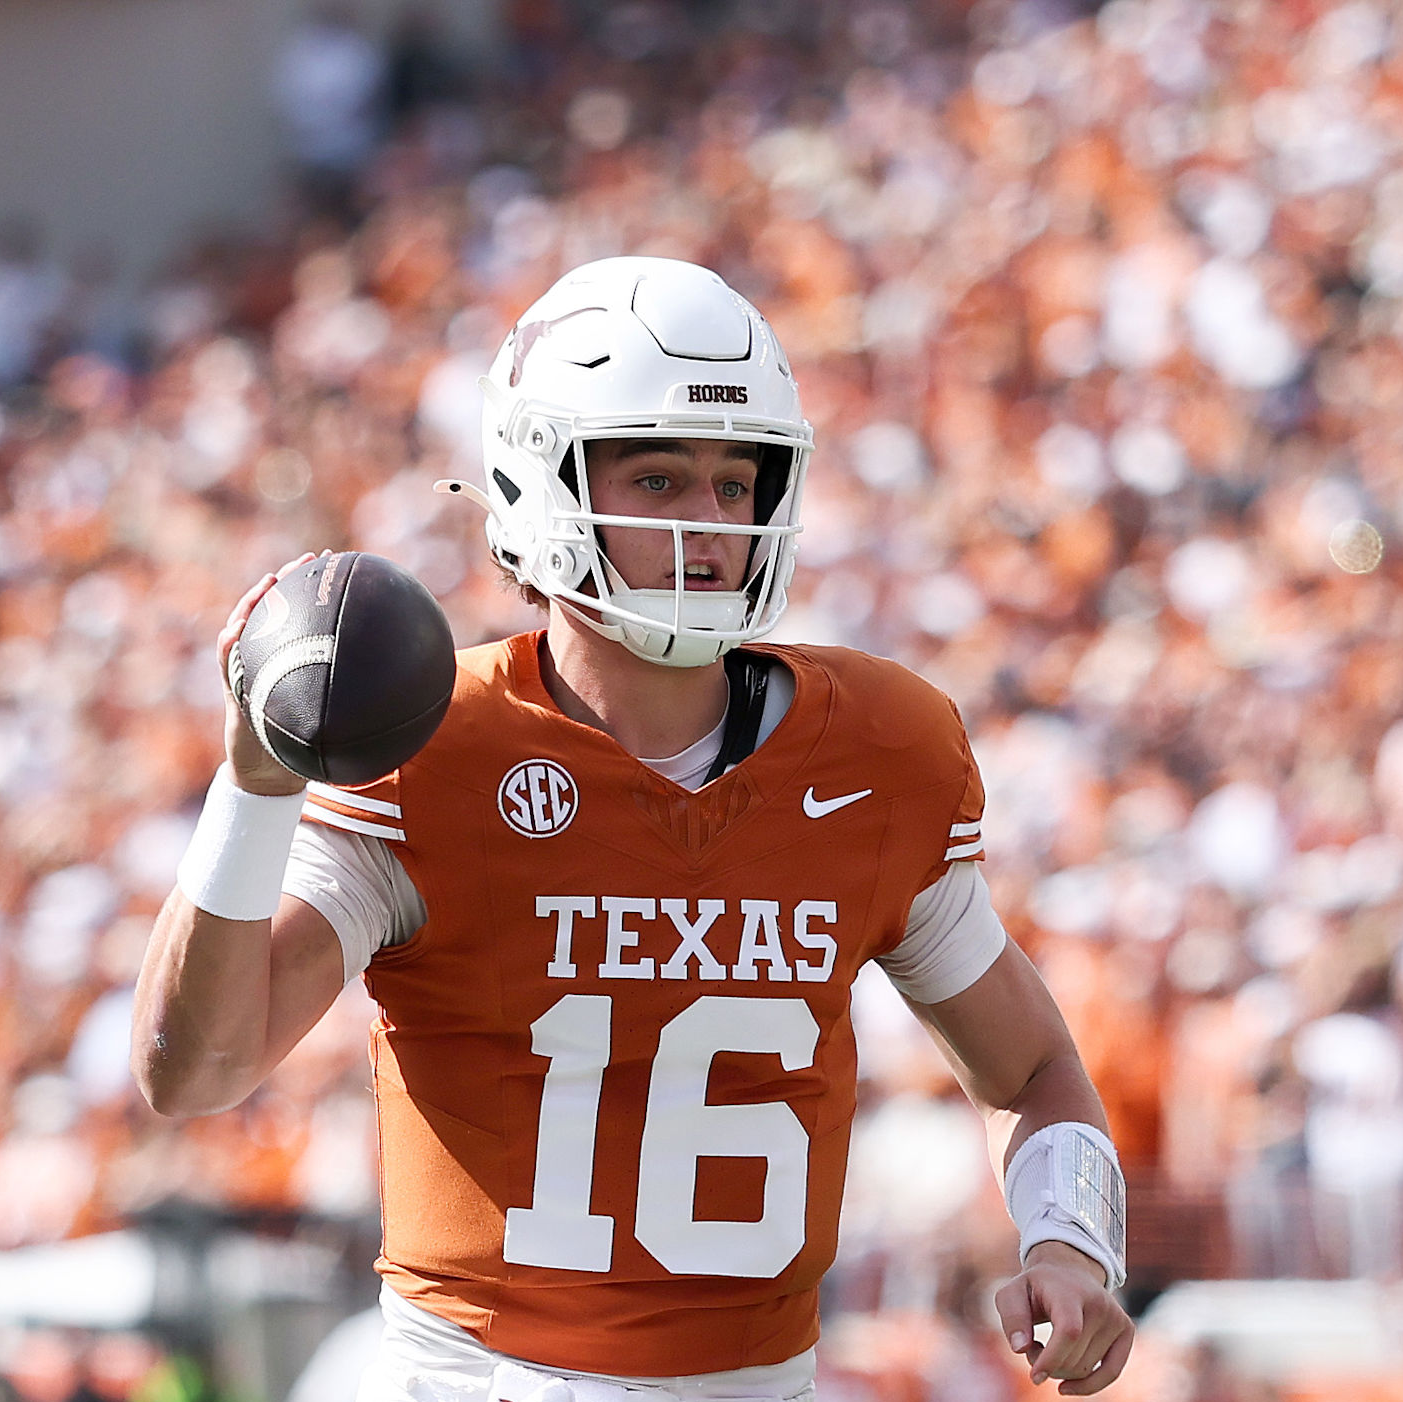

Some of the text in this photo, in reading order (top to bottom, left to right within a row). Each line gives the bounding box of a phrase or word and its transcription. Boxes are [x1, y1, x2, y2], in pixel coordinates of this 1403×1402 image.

[687, 384, 748, 404] HORNS
[505, 765, 572, 832] SEC
[535, 895, 839, 983] TEXAS
[502, 993, 821, 1279] 16
